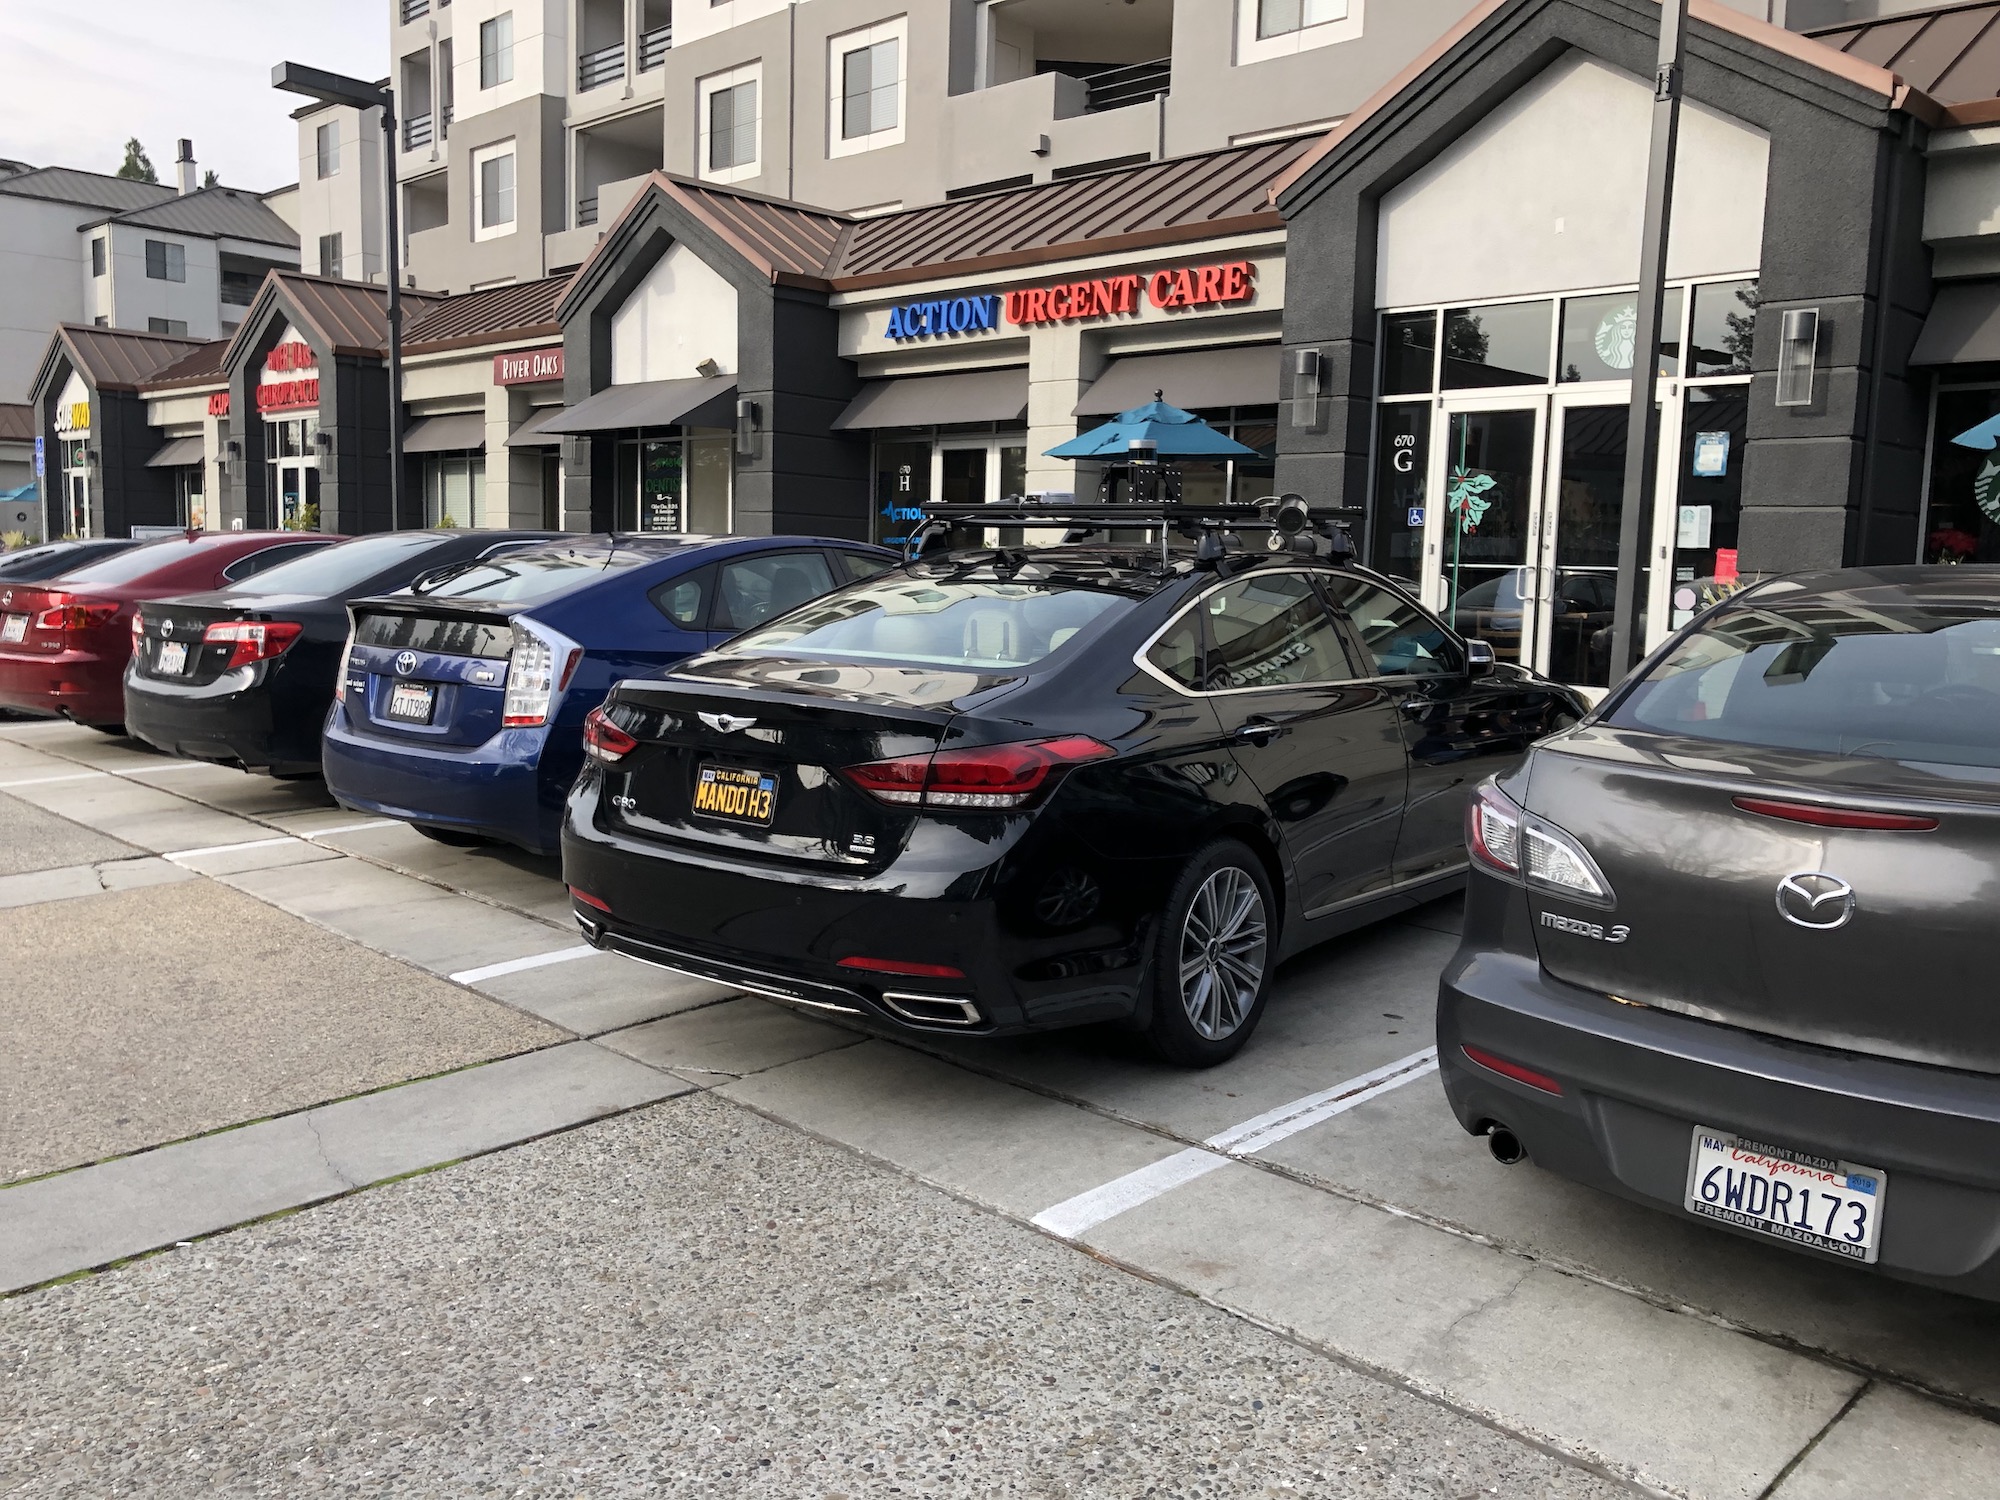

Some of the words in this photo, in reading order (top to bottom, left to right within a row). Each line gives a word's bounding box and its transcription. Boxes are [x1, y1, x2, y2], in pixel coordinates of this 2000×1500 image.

[885, 295, 1000, 339] ACTION
[1005, 274, 1144, 326] URGENT
[1149, 261, 1254, 309] CARE
[502, 358, 530, 380] RIVER
[533, 354, 558, 376] OAKS
[1394, 434, 1415, 447] 670
[1393, 448, 1414, 472] G
[645, 478, 682, 493] DENTIS
[899, 475, 911, 492] H
[716, 770, 759, 786] CALIFORNIA
[695, 782, 748, 815] MANDO
[748, 788, 772, 819] H3
[1604, 924, 1631, 943] 3
[1703, 1136, 1726, 1153] MAY
[1737, 1138, 1792, 1160] FREMONT
[1794, 1152, 1837, 1171] MAZDA
[1731, 1148, 1850, 1190] California
[1701, 1165, 1867, 1243] 6WDR173
[1695, 1201, 1765, 1230] FREMONT
[1770, 1223, 1864, 1258] MAZDA.COM
